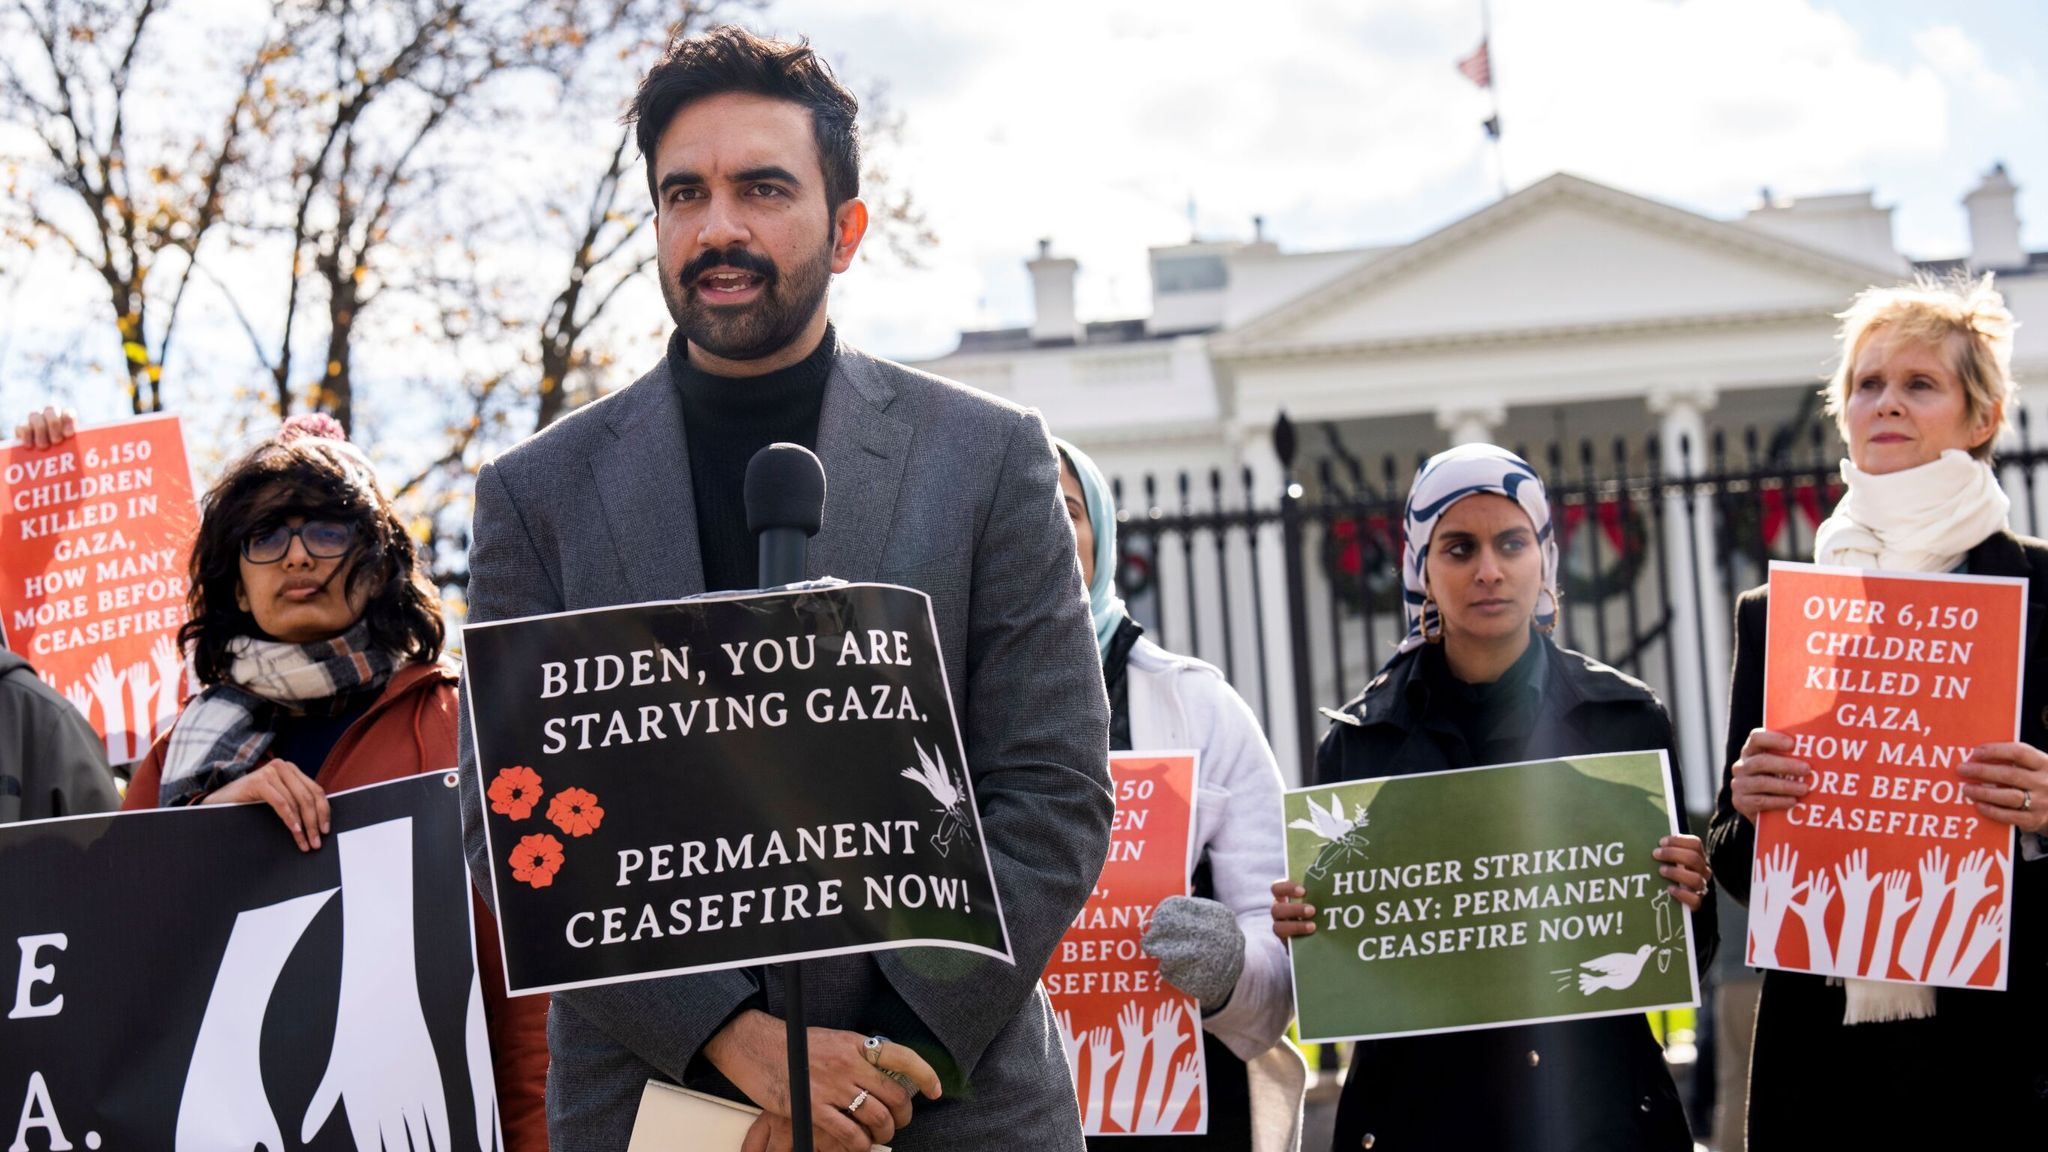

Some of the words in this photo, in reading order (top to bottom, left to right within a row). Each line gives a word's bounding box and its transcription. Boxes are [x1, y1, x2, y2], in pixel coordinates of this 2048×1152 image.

[4, 452, 76, 485] OVER
[84, 440, 152, 469] 6,150
[13, 467, 154, 512] CHILDREN
[20, 504, 118, 541] KILLED
[127, 494, 158, 519] IN
[53, 529, 136, 562] GAZA,
[24, 566, 87, 599] HOW
[96, 548, 177, 583] MANY
[13, 596, 89, 631] MORE
[97, 575, 193, 613] BEFOR
[1803, 595, 1885, 625] OVER
[1897, 603, 1979, 632] 6,150
[540, 645, 707, 700] BIDEN,
[721, 634, 816, 677] YOU
[835, 629, 913, 666] ARE
[1805, 631, 1974, 665] CHILDREN
[1803, 665, 1921, 697] KILLED
[1930, 675, 1971, 700] IN
[541, 694, 788, 755] STARVING
[805, 684, 929, 724] GAZA.
[1836, 703, 1932, 737] GAZA,
[1791, 733, 1867, 762] HOW
[1876, 741, 1975, 769] MANY
[1785, 802, 1980, 841] CEASEFIRE?
[615, 820, 919, 887] PERMANENT
[1107, 839, 1146, 863] IN
[1331, 859, 1464, 897] HUNGER
[1472, 841, 1626, 882] STRIKING
[565, 879, 844, 949] CEASEFIRE
[863, 873, 972, 914] NOW!
[1323, 904, 1365, 931] TO
[1374, 896, 1442, 926] SAY:
[1453, 873, 1652, 918] PERMANENT
[1061, 938, 1159, 963] BEFO
[1357, 921, 1528, 963] CEASEFIRE
[1537, 911, 1625, 943] NOW!
